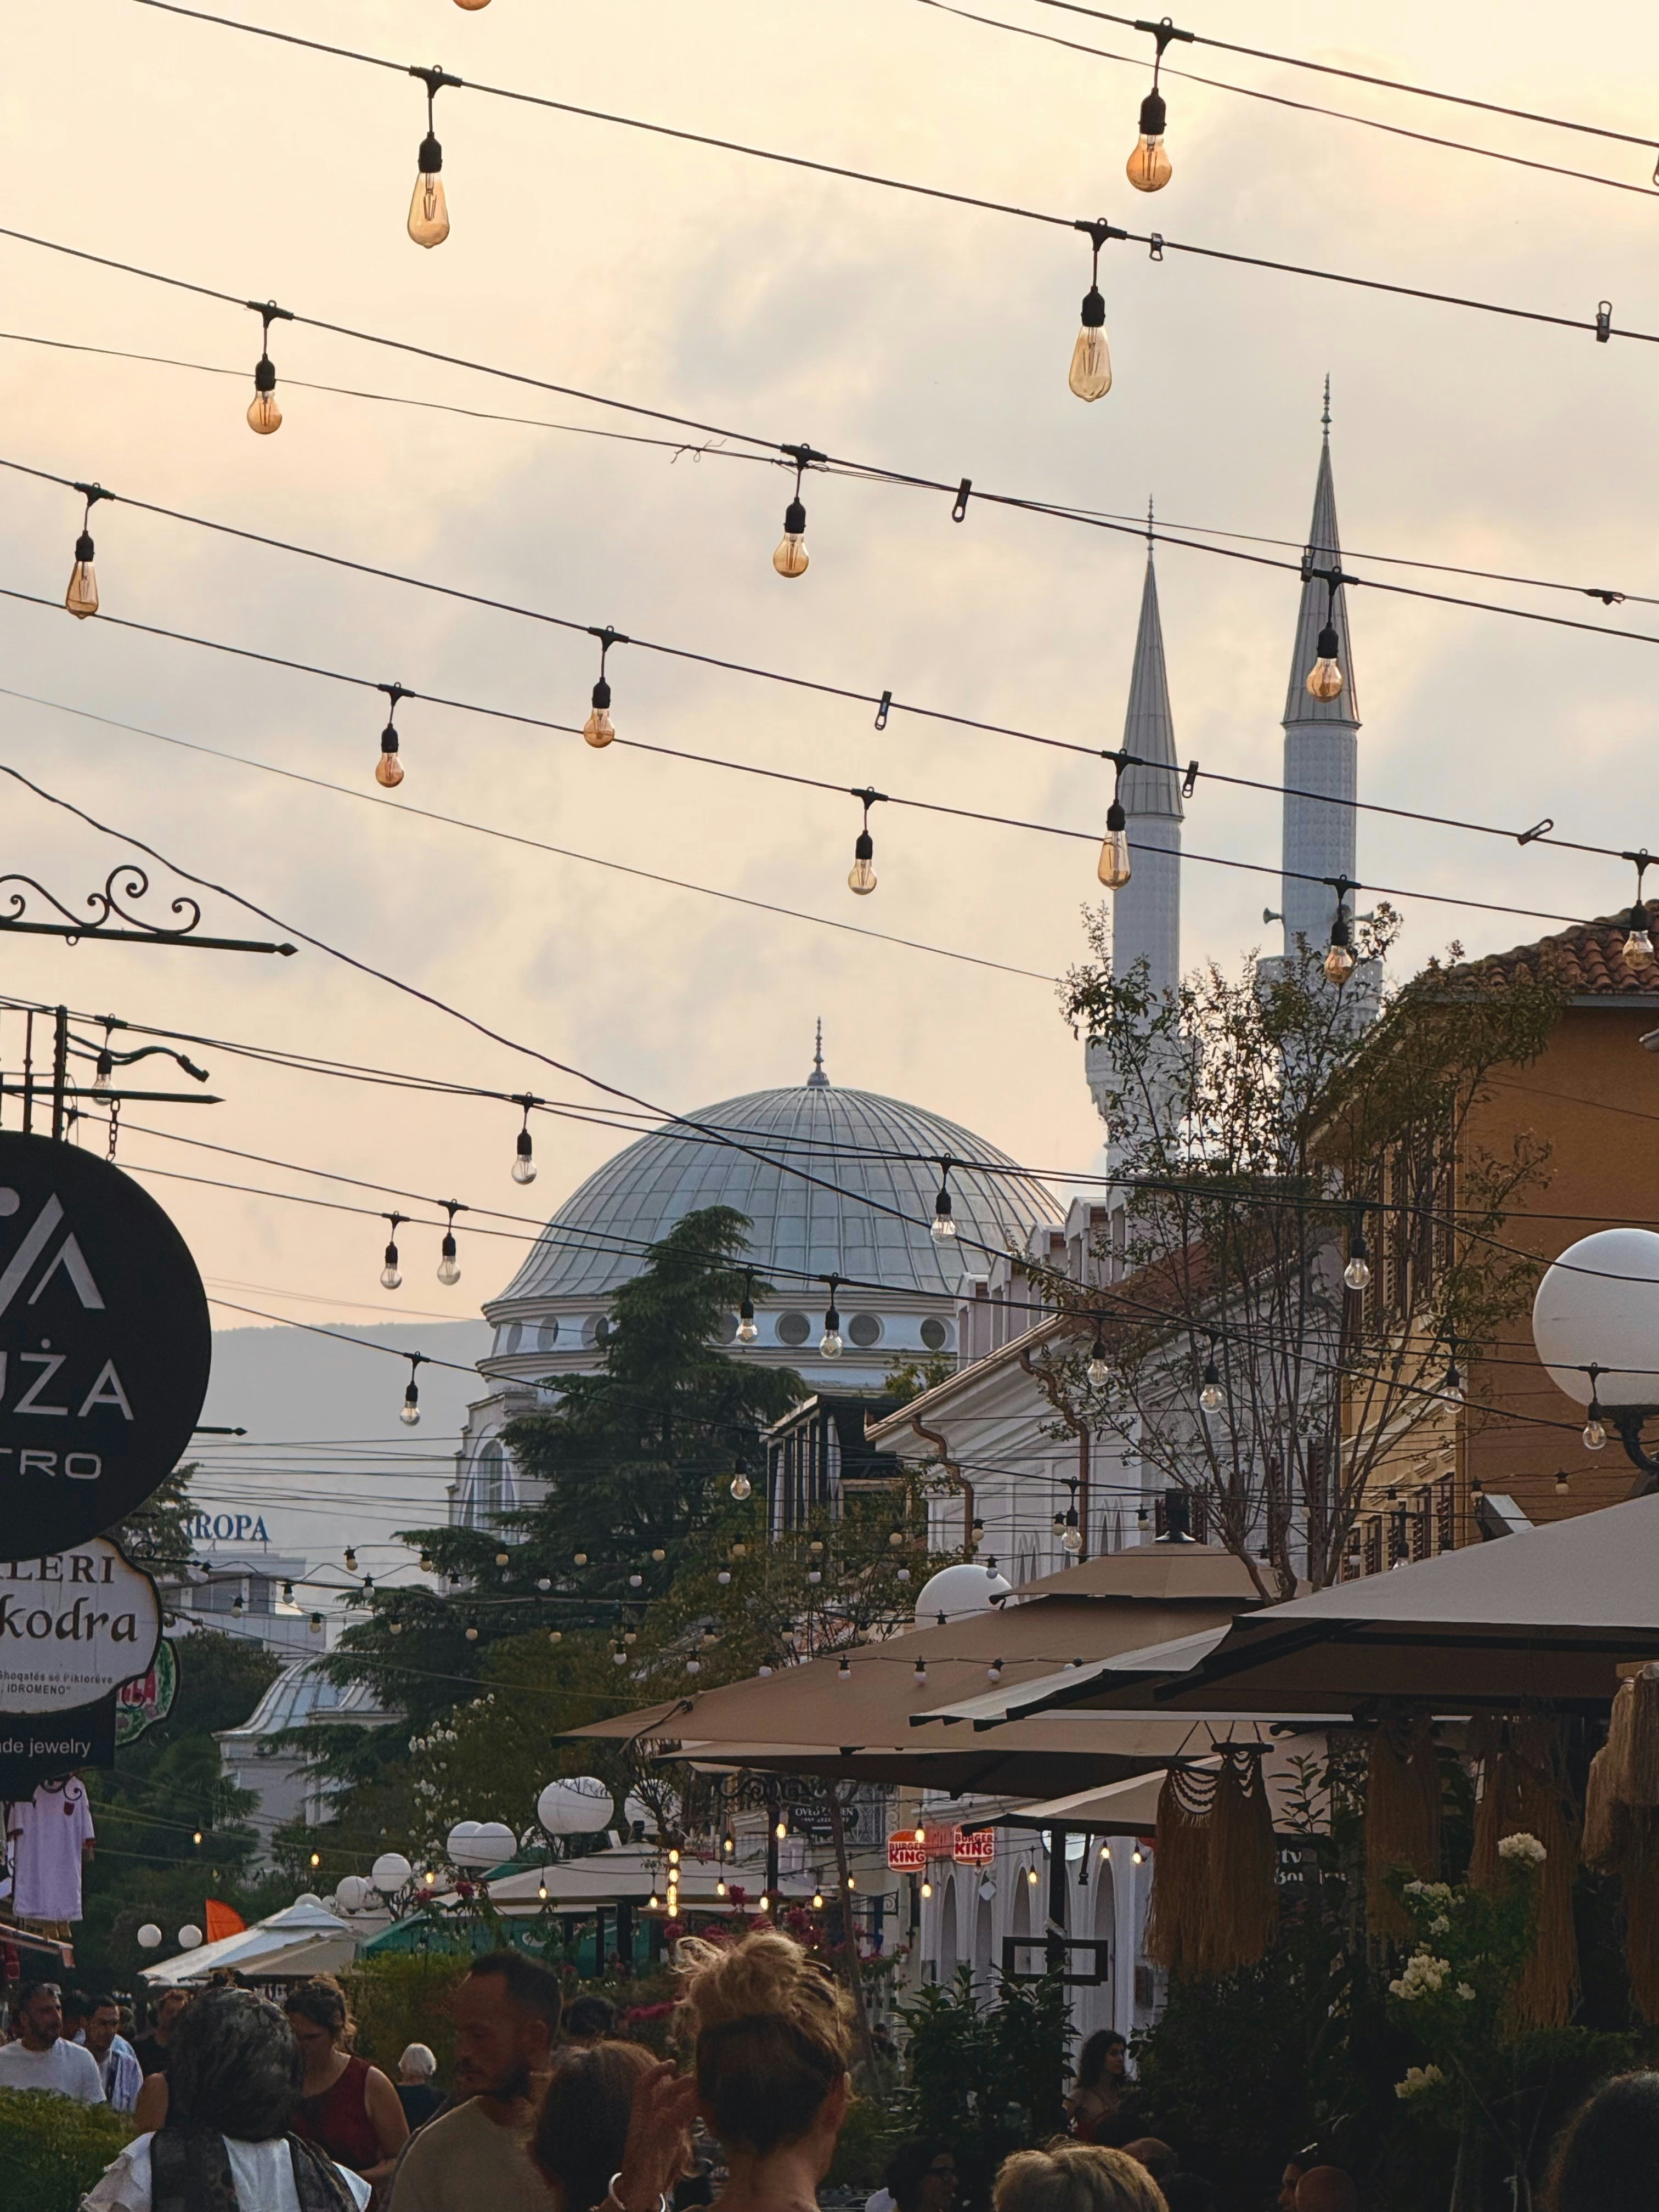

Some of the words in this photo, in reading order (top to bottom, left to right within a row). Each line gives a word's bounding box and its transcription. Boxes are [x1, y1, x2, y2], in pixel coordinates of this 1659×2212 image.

[0, 1338, 134, 1421] ŻA
[0, 1555, 115, 1584] LERI
[29, 1737, 91, 1758] jewelry
[955, 1834, 994, 1843] BURGER
[889, 1842, 926, 1851] BURGER
[955, 1842, 993, 1855] KING
[889, 1850, 926, 1863] KING
